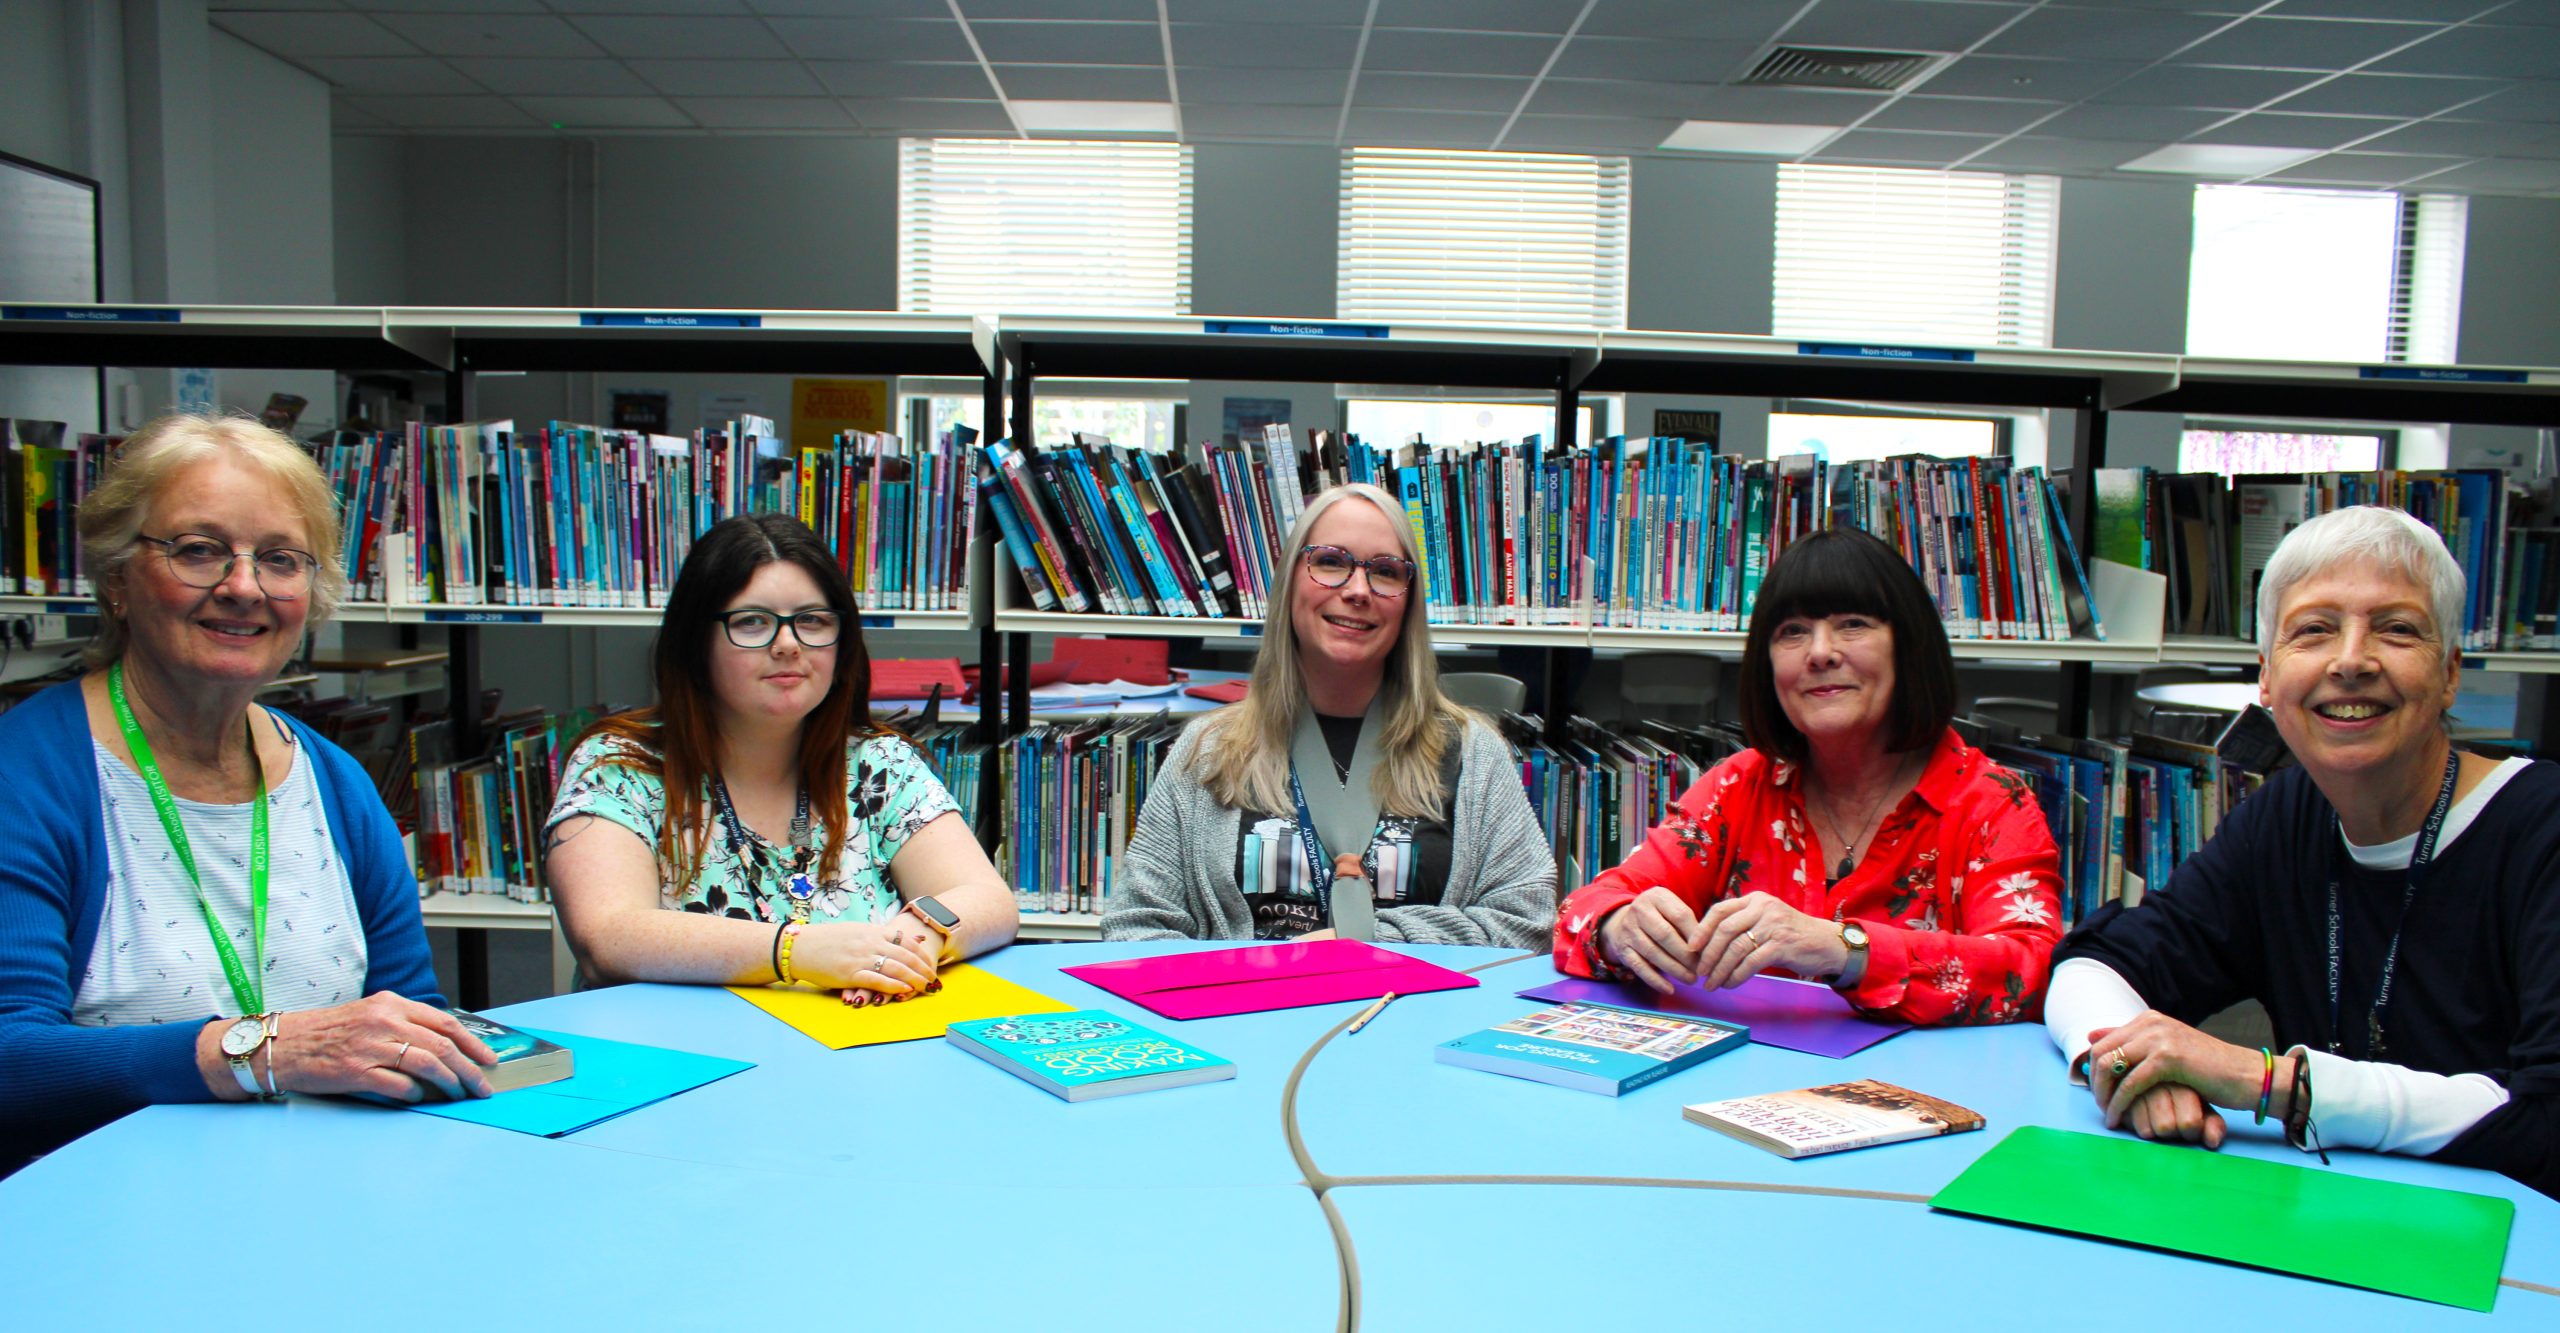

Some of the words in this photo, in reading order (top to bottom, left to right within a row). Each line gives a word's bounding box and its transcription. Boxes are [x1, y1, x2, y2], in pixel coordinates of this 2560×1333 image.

[66, 311, 119, 321] Non-fiction
[644, 316, 697, 326] Non-fiction
[1270, 324, 1324, 335] Non-fiction
[1860, 347, 1913, 358] Non-fiction
[2420, 370, 2469, 380] Non-fiction
[1505, 482, 1511, 491] ME
[1549, 473, 1558, 489] 100
[1549, 512, 1557, 535] SAVING
[1549, 536, 1557, 546] THE
[1505, 553, 1513, 577] ALVIN
[1549, 548, 1557, 571] PLANET
[1747, 542, 1761, 566] LAW
[1506, 578, 1514, 599] HALL
[464, 613, 503, 622] 200-299
[145, 764, 172, 804] VISITOR
[799, 790, 810, 820] ACULTY
[1296, 787, 1305, 808] Turner
[161, 802, 186, 845] Schools
[724, 807, 740, 840] Schools
[1610, 814, 1618, 841] Earth
[2415, 830, 2435, 866] Turner
[2427, 790, 2449, 831] Schools
[256, 831, 266, 872] VISITOR
[1303, 827, 1316, 861] FACULTY
[1310, 858, 1322, 886] Schools
[1316, 887, 1328, 913] Turner
[2328, 881, 2340, 914] Turner
[2328, 914, 2340, 955] Schools
[222, 948, 247, 989] Schools
[2329, 955, 2340, 1003] FACULTY
[2375, 968, 2393, 1007] Turner
[1033, 1040, 1170, 1061] PROGRESS?
[1045, 1046, 1183, 1069] GOOD
[1528, 1049, 1600, 1064] READING
[1062, 1053, 1206, 1077] MAKING
[1754, 1098, 1794, 1112] Boy
[1712, 1108, 1812, 1142] michael
[1721, 1101, 1832, 1139] morpurgo
[1797, 1111, 1857, 1135] Farm
